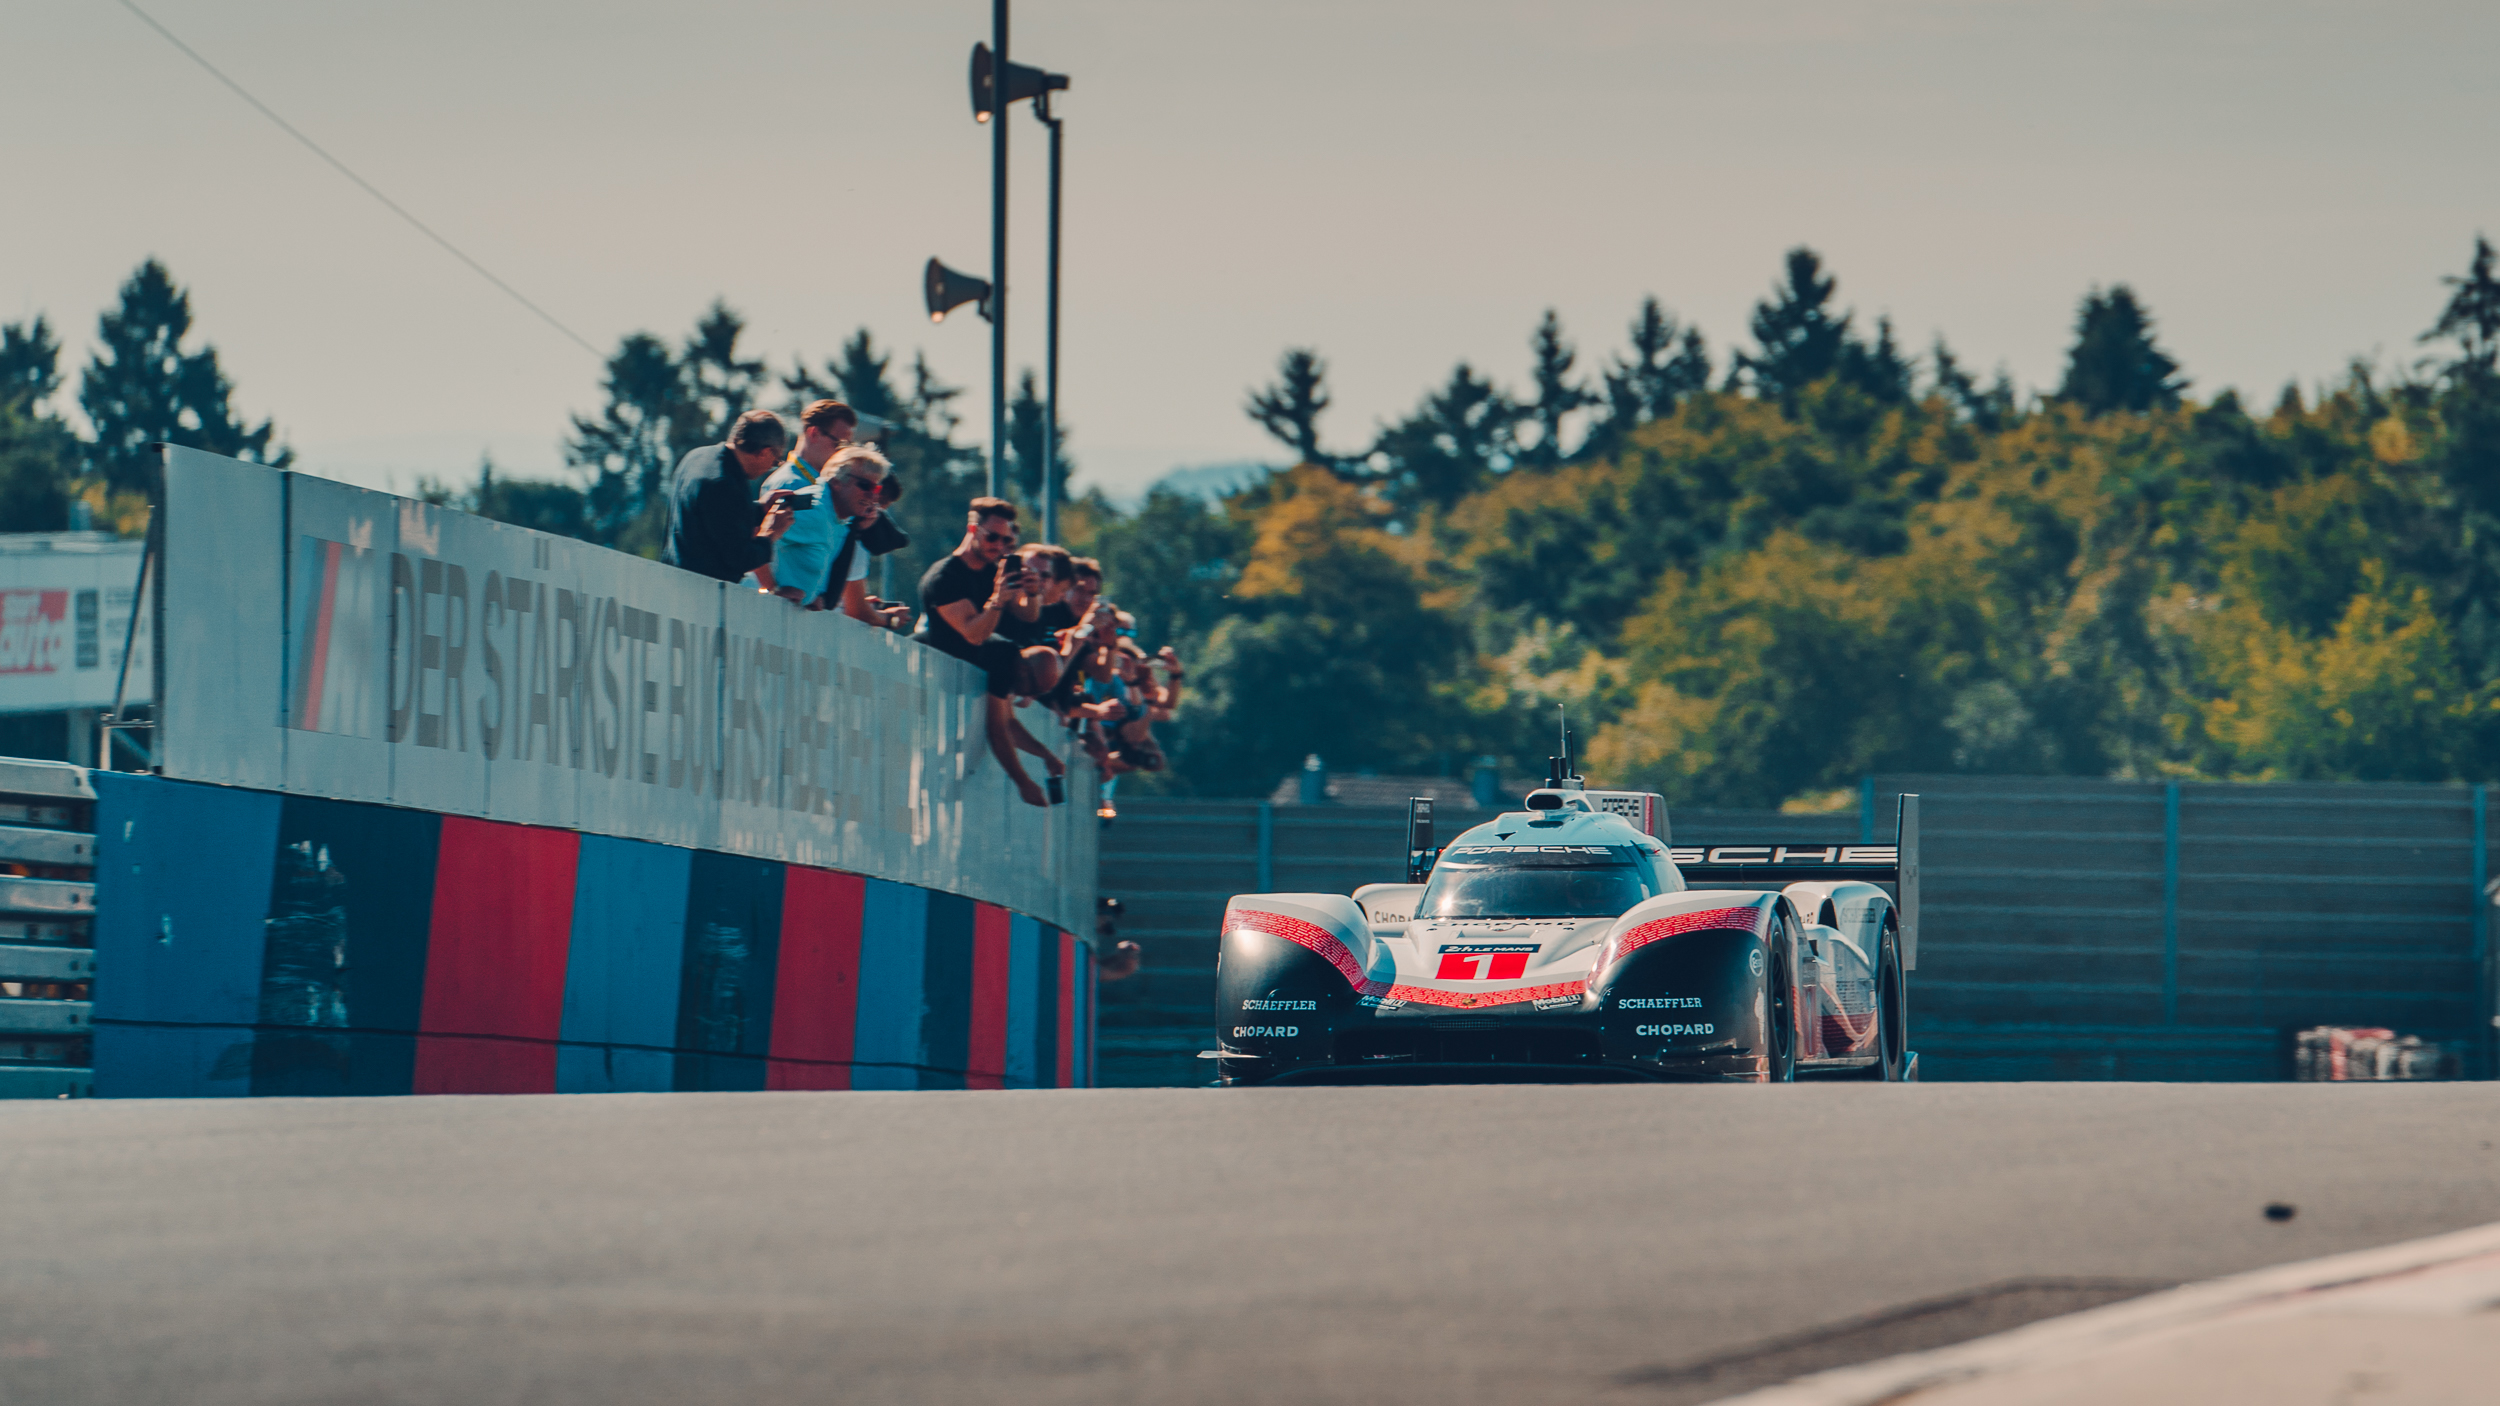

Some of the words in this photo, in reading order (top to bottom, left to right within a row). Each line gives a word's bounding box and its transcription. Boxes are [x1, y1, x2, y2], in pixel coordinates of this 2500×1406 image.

[384, 552, 468, 752] DER
[478, 537, 660, 785] STÄRKSTE
[1451, 845, 1612, 857] PORSCHE
[1463, 954, 1494, 980] 1
[1242, 999, 1317, 1011] SCHAEFFLER
[1532, 996, 1568, 1006] Mobil
[1618, 997, 1703, 1010] SCHAEFFLER
[1233, 1025, 1299, 1038] CHOPARD
[1635, 1023, 1715, 1036] CHOPARD
